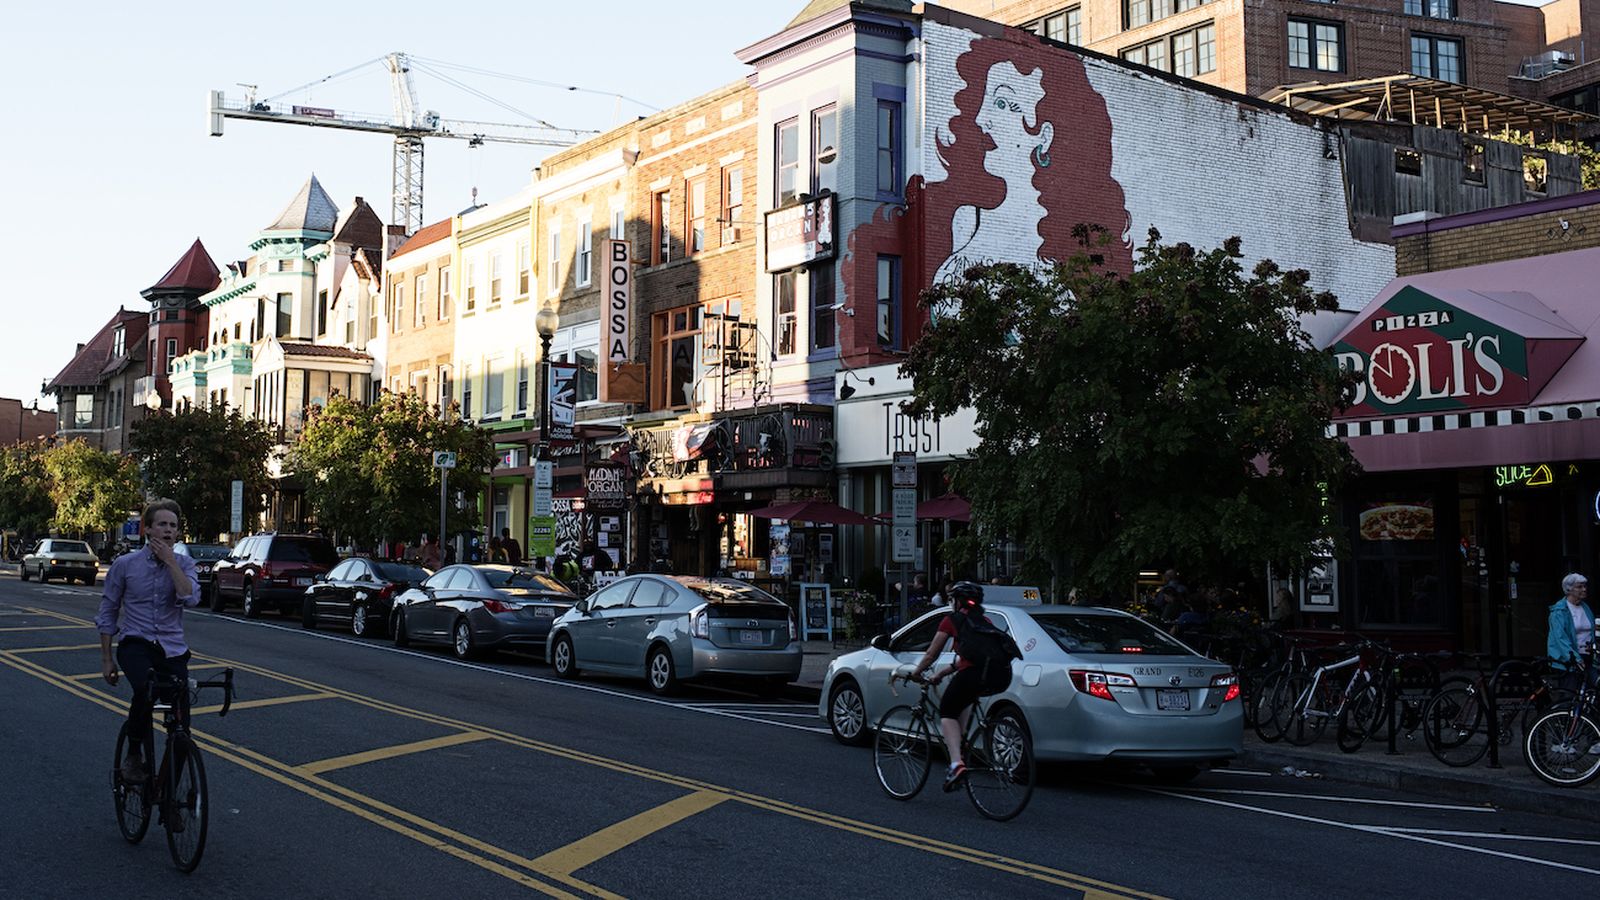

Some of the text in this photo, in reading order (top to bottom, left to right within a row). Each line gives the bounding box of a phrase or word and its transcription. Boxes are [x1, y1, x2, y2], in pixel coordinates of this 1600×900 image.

[610, 242, 628, 359] BOSSA
[1375, 311, 1451, 331] PIZZA
[1333, 332, 1505, 405] BOLI'S
[551, 369, 575, 427] EAT
[588, 480, 624, 492] ORGAN
[1495, 464, 1532, 487] SLICE
[1133, 667, 1205, 678] GRAND E126
